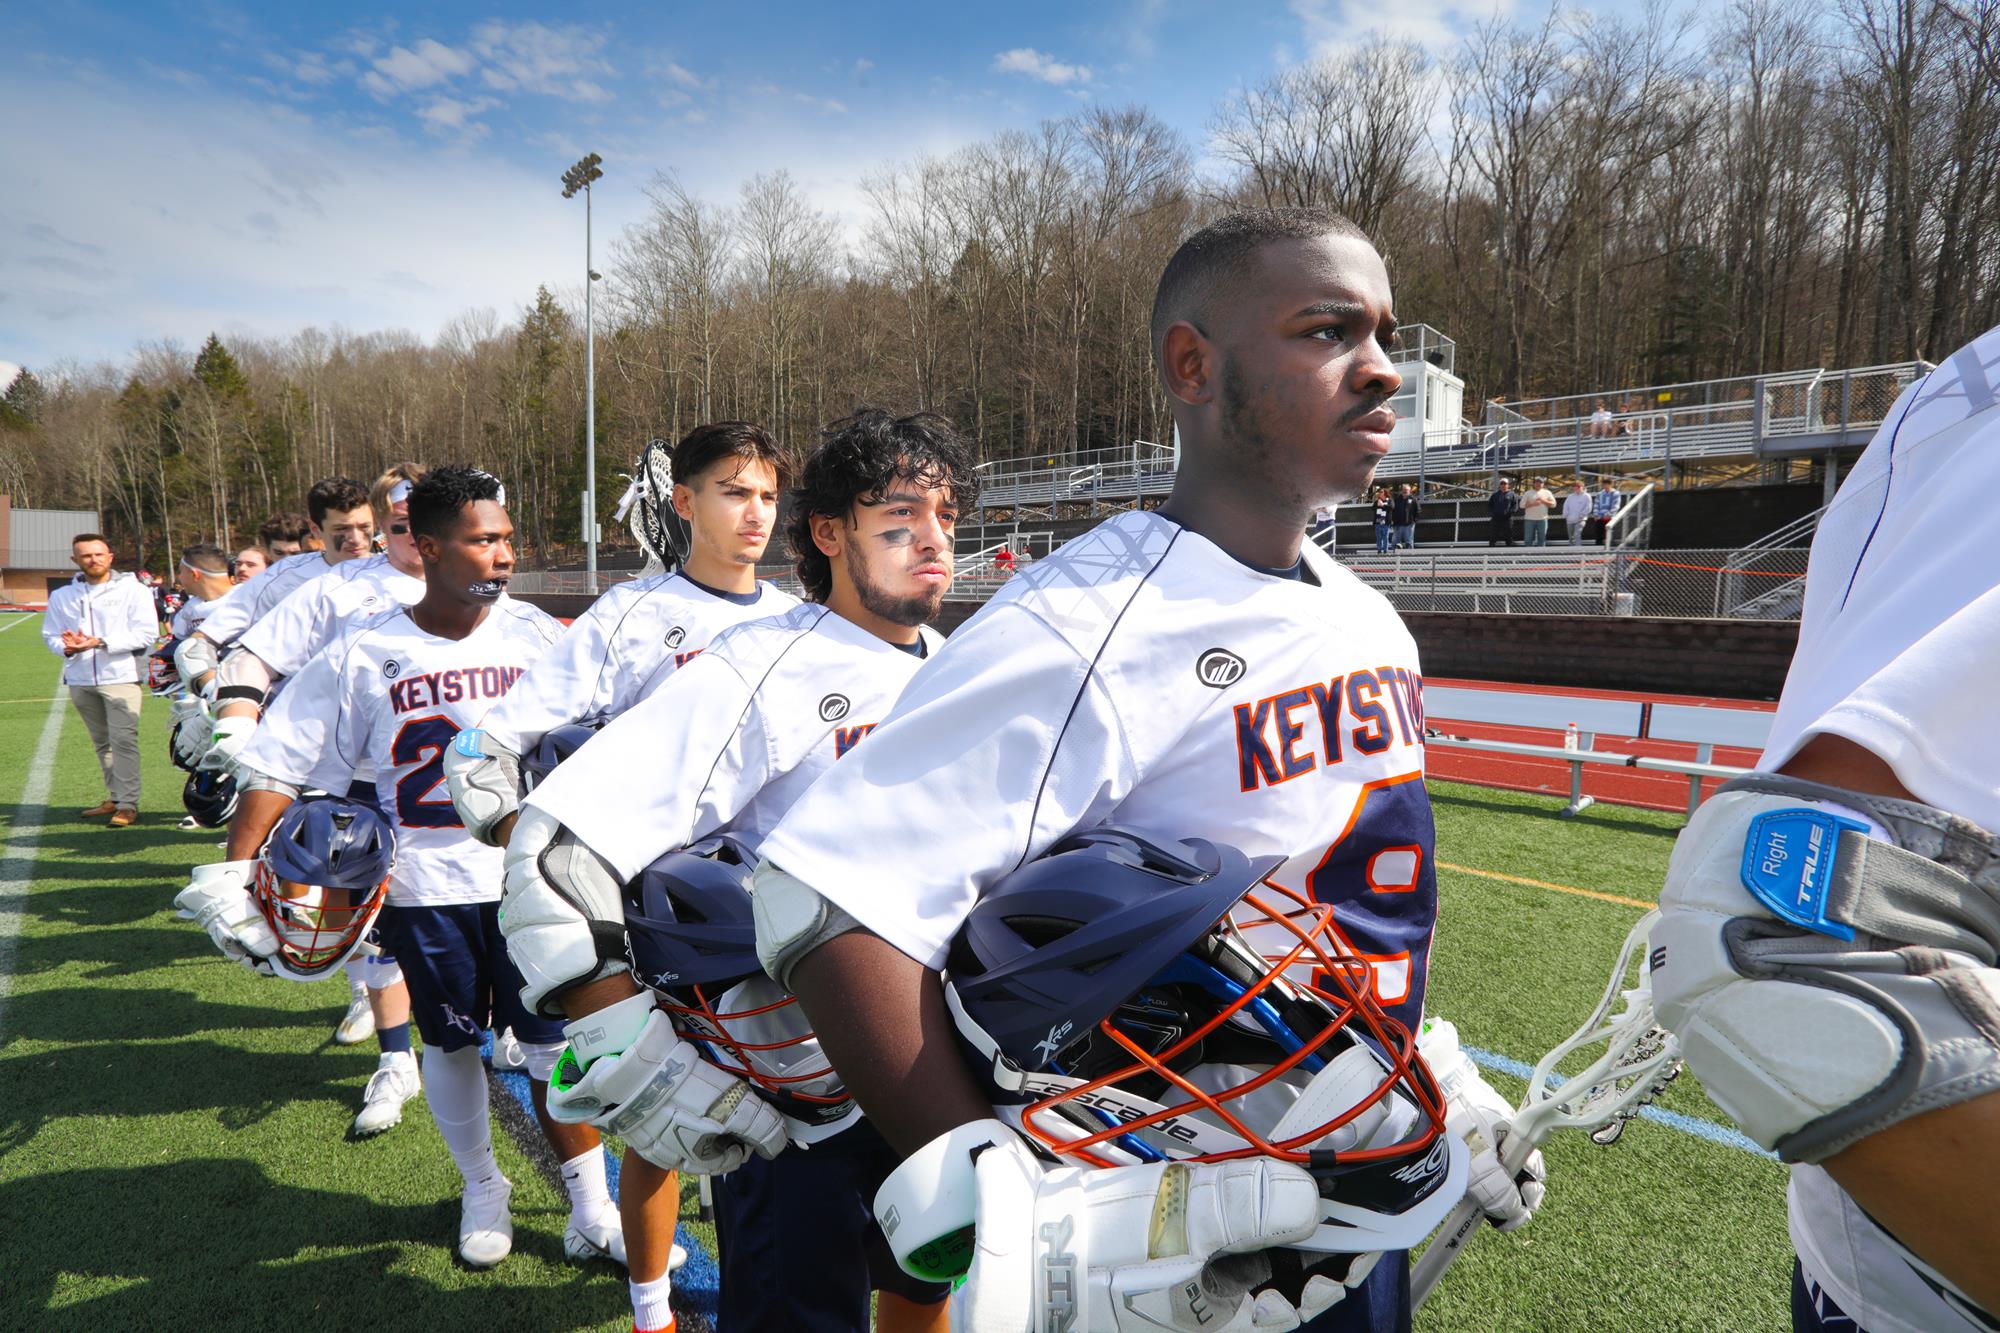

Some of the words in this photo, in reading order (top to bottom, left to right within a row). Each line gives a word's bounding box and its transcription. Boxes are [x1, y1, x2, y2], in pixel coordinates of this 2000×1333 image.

[1762, 831, 1788, 876] Right
[1797, 824, 1823, 906] TRUE
[651, 971, 680, 986] XRS
[1032, 1019, 1073, 1064] XRS
